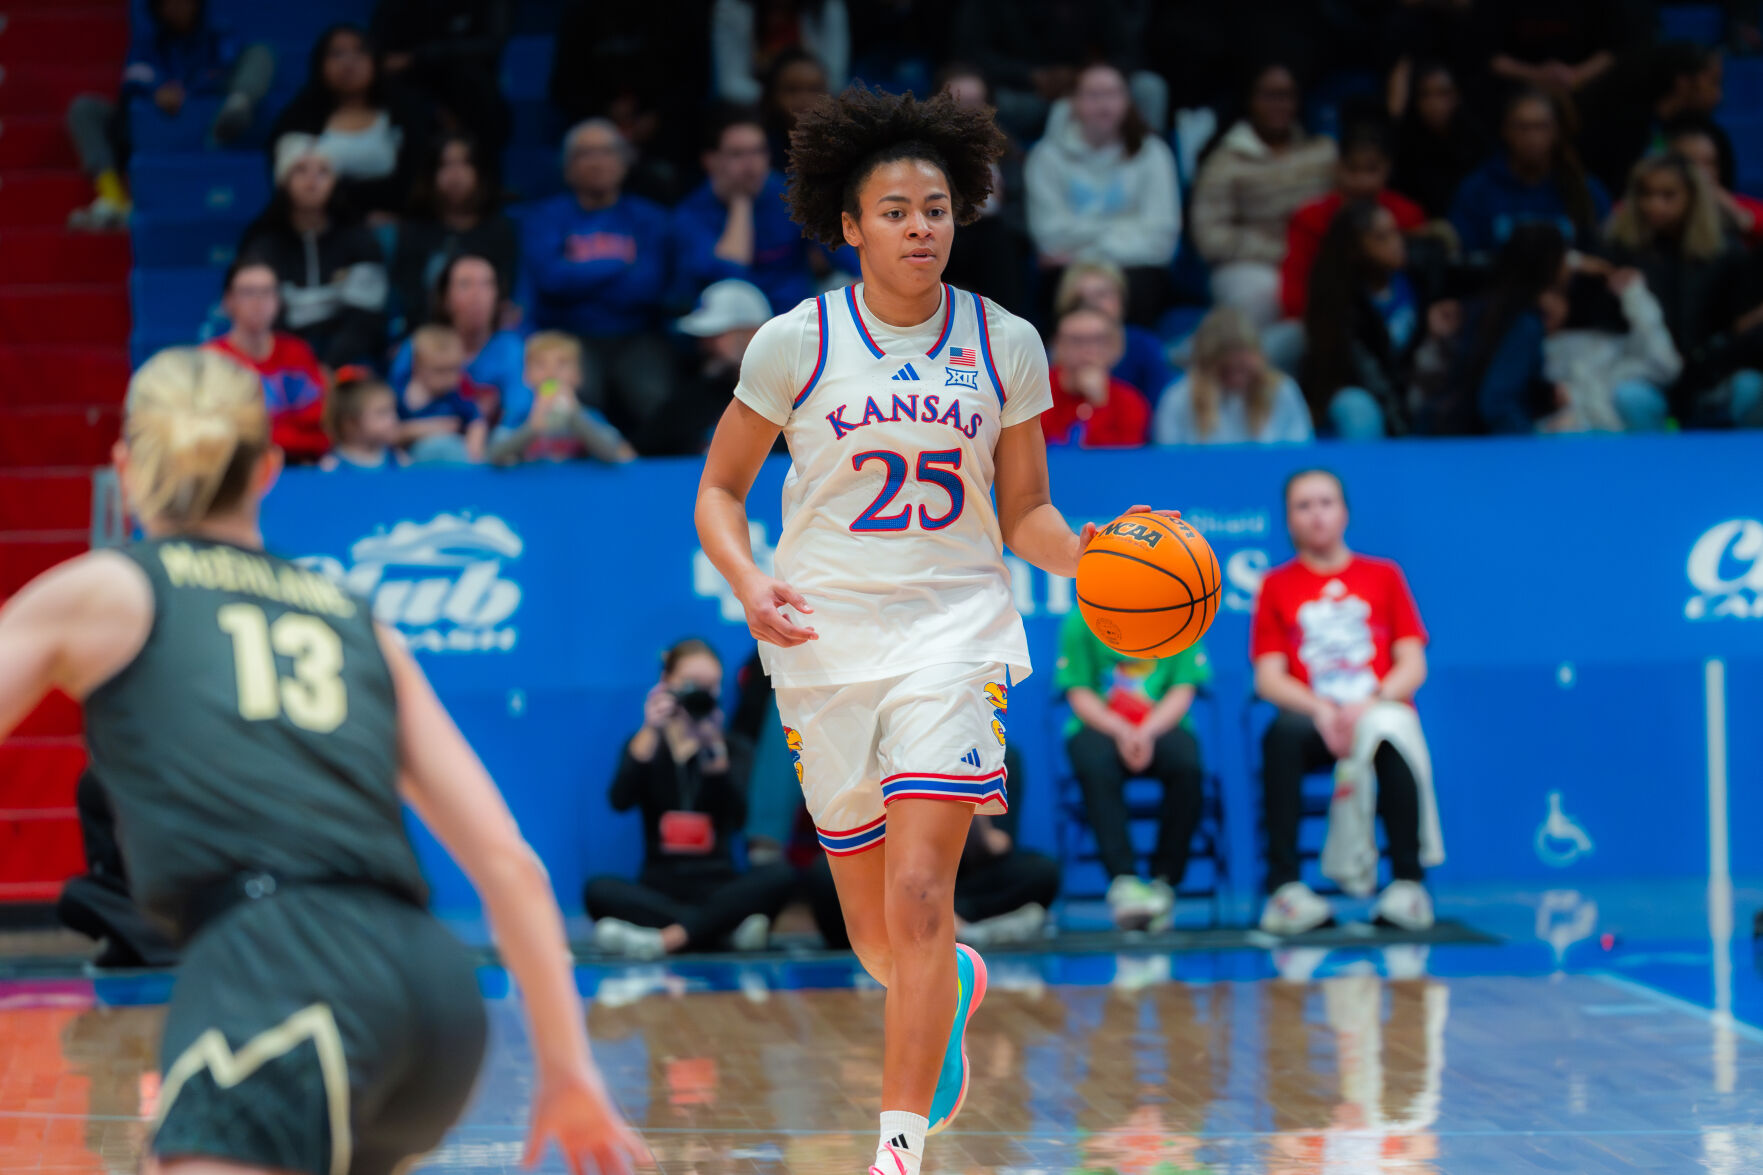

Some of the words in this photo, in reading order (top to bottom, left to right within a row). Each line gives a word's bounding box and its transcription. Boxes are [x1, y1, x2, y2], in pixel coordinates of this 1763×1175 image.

[826, 394, 982, 440] KANSAS
[850, 447, 965, 532] 25
[1099, 522, 1163, 548] NCAA
[217, 602, 349, 734] 13
